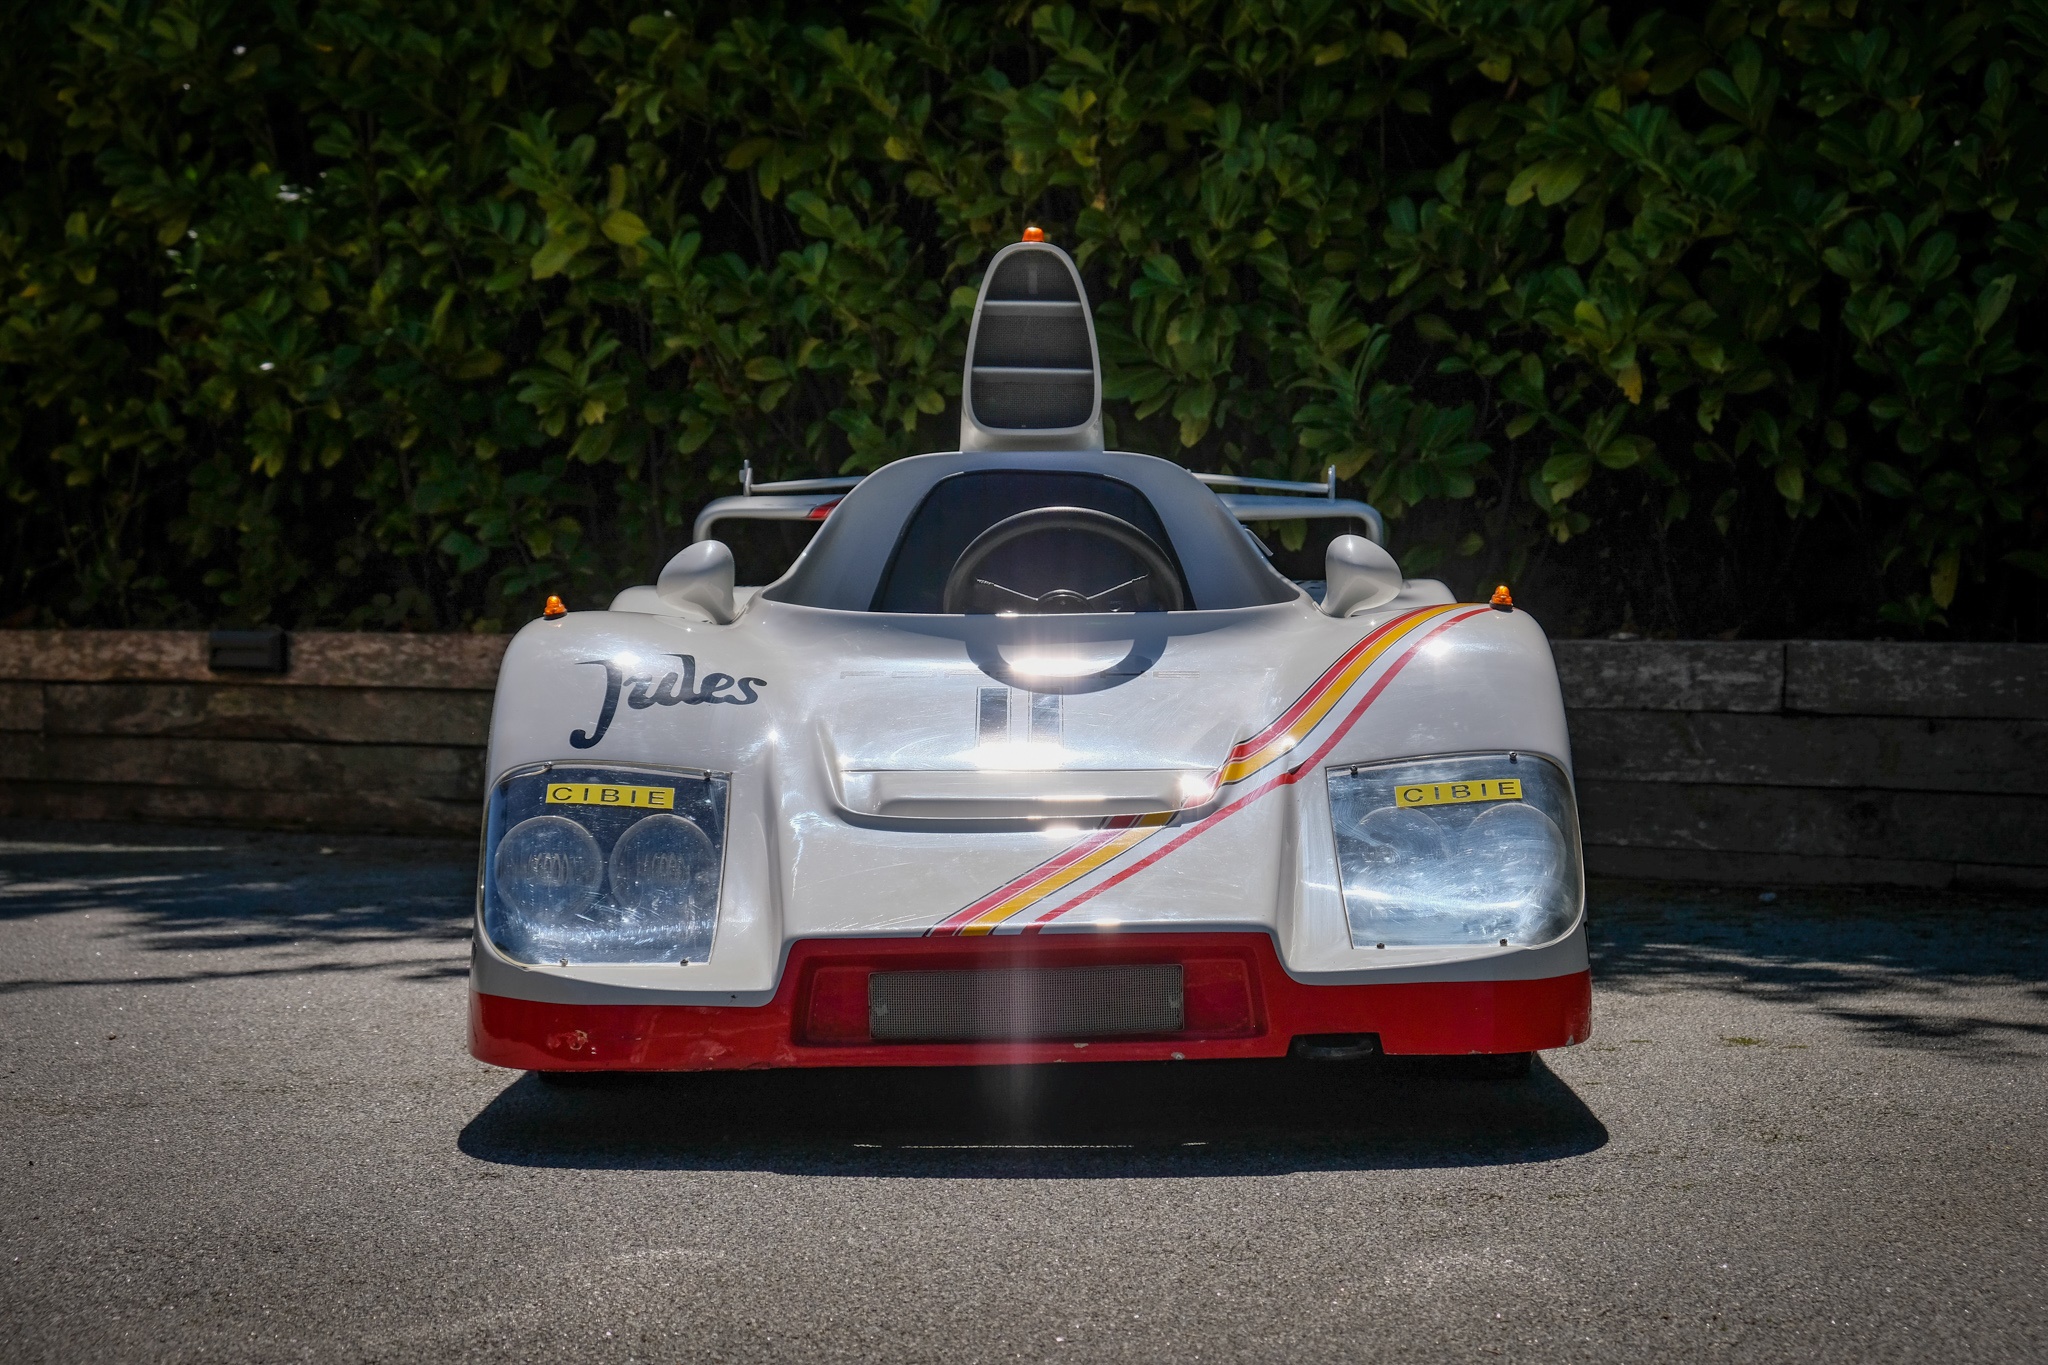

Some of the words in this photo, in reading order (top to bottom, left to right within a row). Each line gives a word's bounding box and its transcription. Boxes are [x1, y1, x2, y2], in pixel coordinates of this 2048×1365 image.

[839, 670, 1200, 680] PORHE
[569, 653, 767, 749] Jules
[552, 787, 665, 805] CIBIE
[1403, 781, 1516, 803] CIBIE
